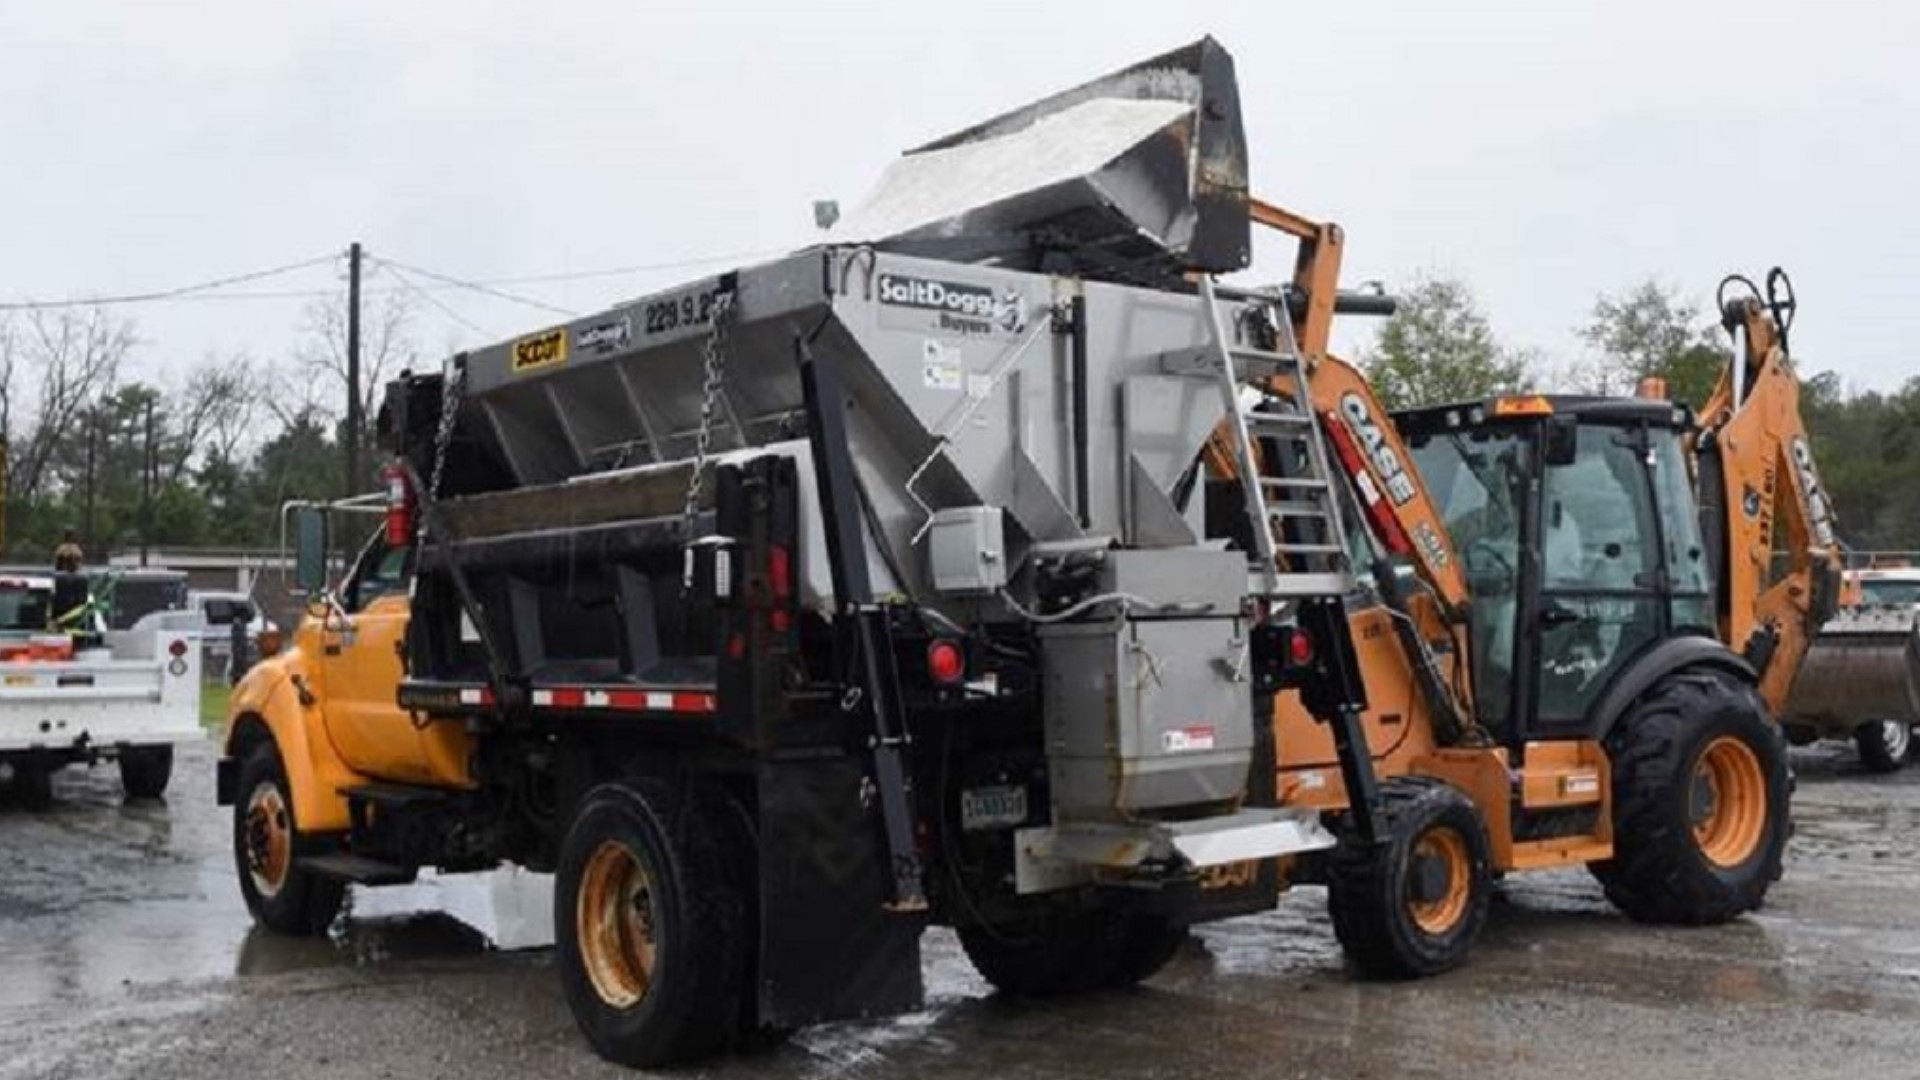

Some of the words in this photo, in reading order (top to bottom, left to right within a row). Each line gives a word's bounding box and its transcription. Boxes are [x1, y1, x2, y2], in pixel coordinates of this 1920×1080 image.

[880, 277, 991, 317] SaltDogg
[940, 313, 991, 333] Buyers
[515, 331, 562, 368] SCDOT
[1341, 391, 1415, 507] CASE
